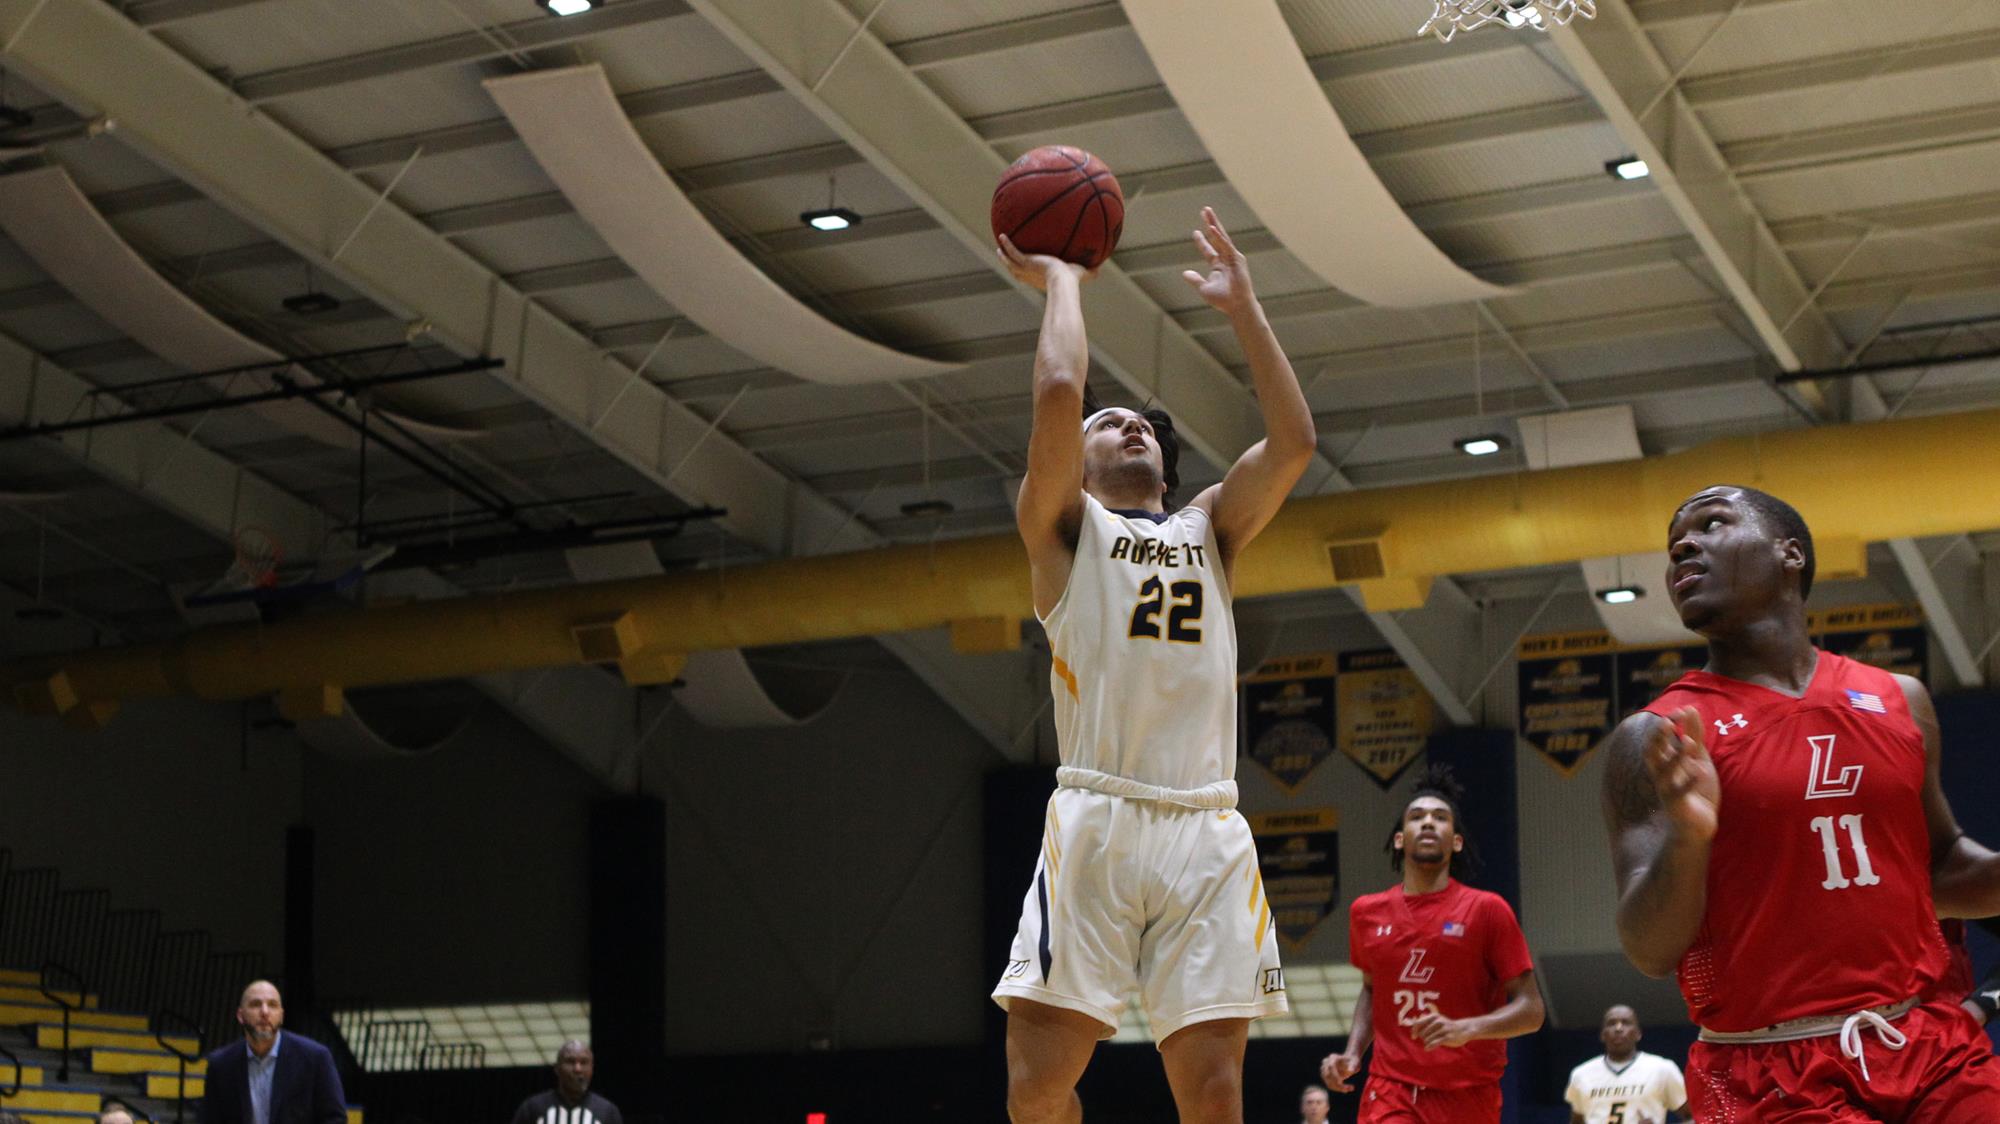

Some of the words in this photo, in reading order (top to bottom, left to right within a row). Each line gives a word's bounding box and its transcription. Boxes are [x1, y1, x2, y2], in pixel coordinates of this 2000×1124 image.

[1128, 573, 1204, 645] 22
[1804, 734, 1864, 800] L
[1810, 814, 1880, 890] 11
[1398, 949, 1435, 984] L
[1393, 989, 1440, 1027] 25
[1608, 1102, 1627, 1124] 5
